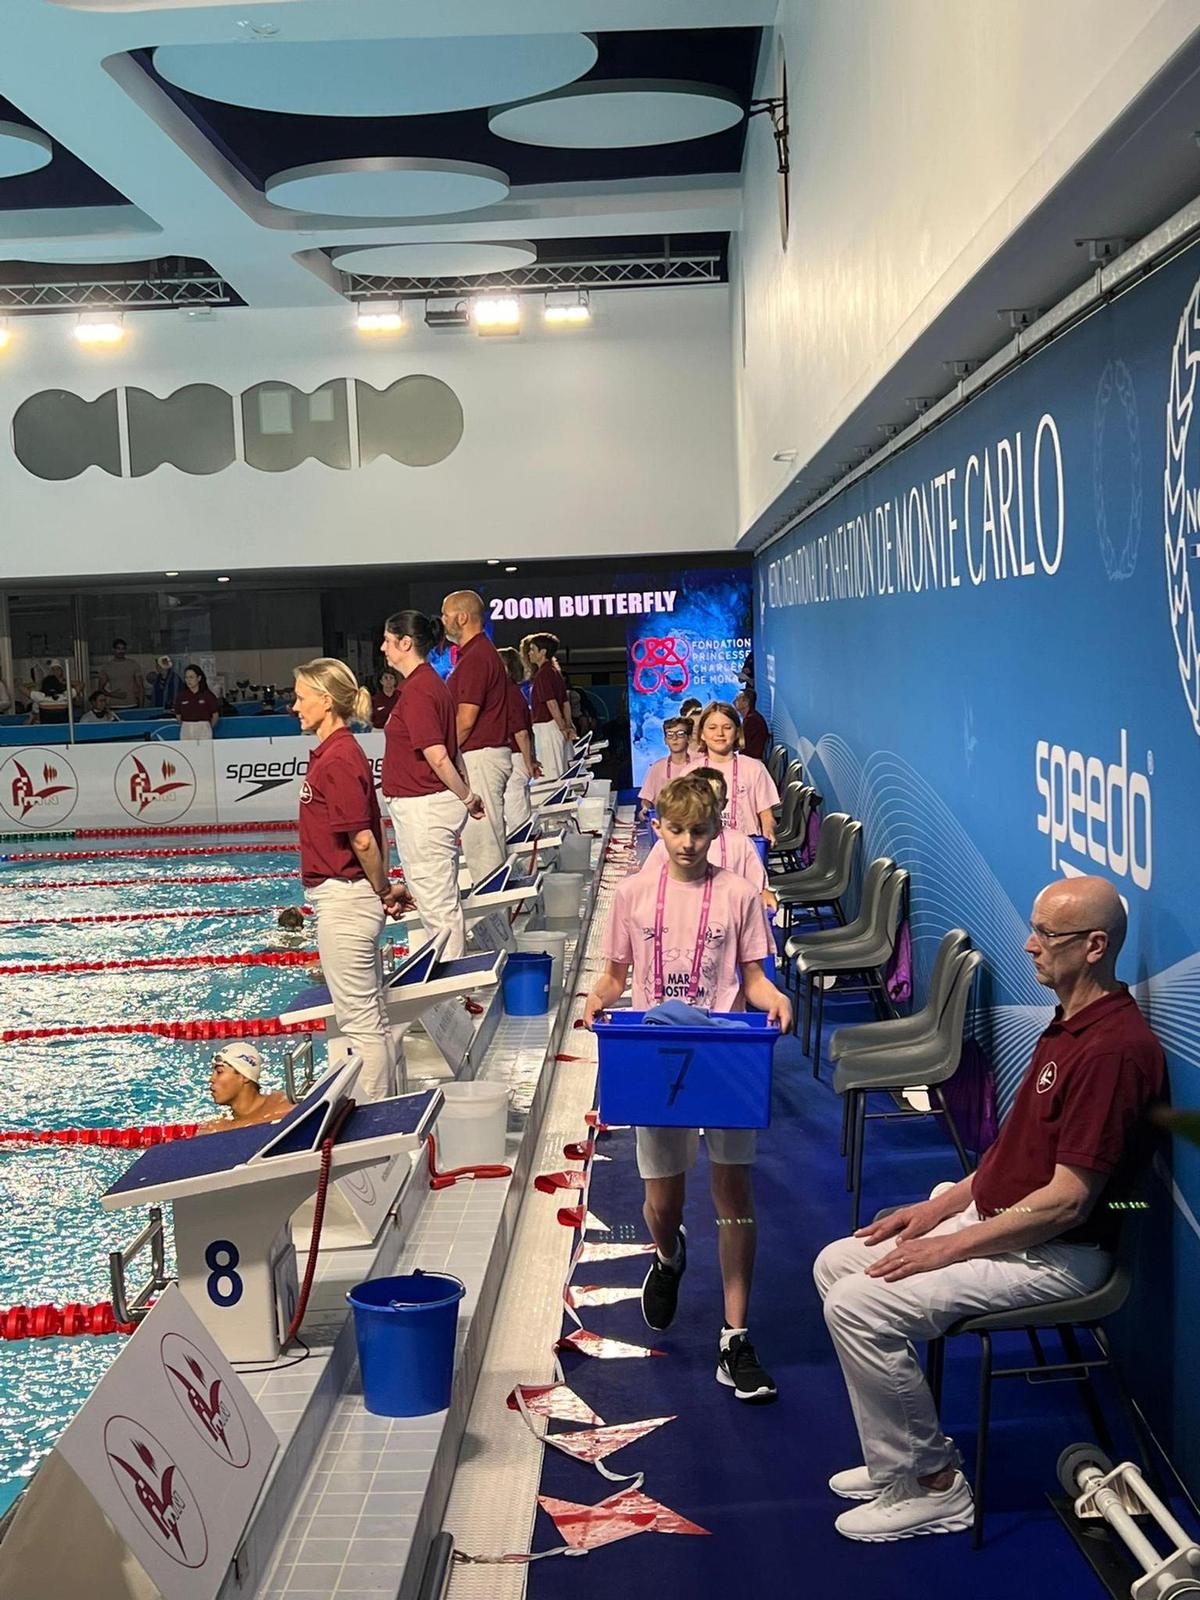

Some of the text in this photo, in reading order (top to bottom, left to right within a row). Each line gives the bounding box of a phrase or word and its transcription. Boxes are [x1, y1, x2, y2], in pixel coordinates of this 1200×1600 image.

[829, 511, 875, 601] NATATION
[876, 502, 894, 595] DE
[895, 467, 961, 593] MONTE
[964, 413, 1064, 586] CARLO
[489, 590, 677, 620] 200M BUTTERFLY
[691, 638, 751, 650] FONDATION
[693, 675, 706, 685] DE
[226, 757, 309, 783] speedo
[1036, 728, 1152, 891] speedo
[668, 973, 691, 985] MAR
[658, 1047, 696, 1107] 7
[205, 1239, 243, 1307] 8
